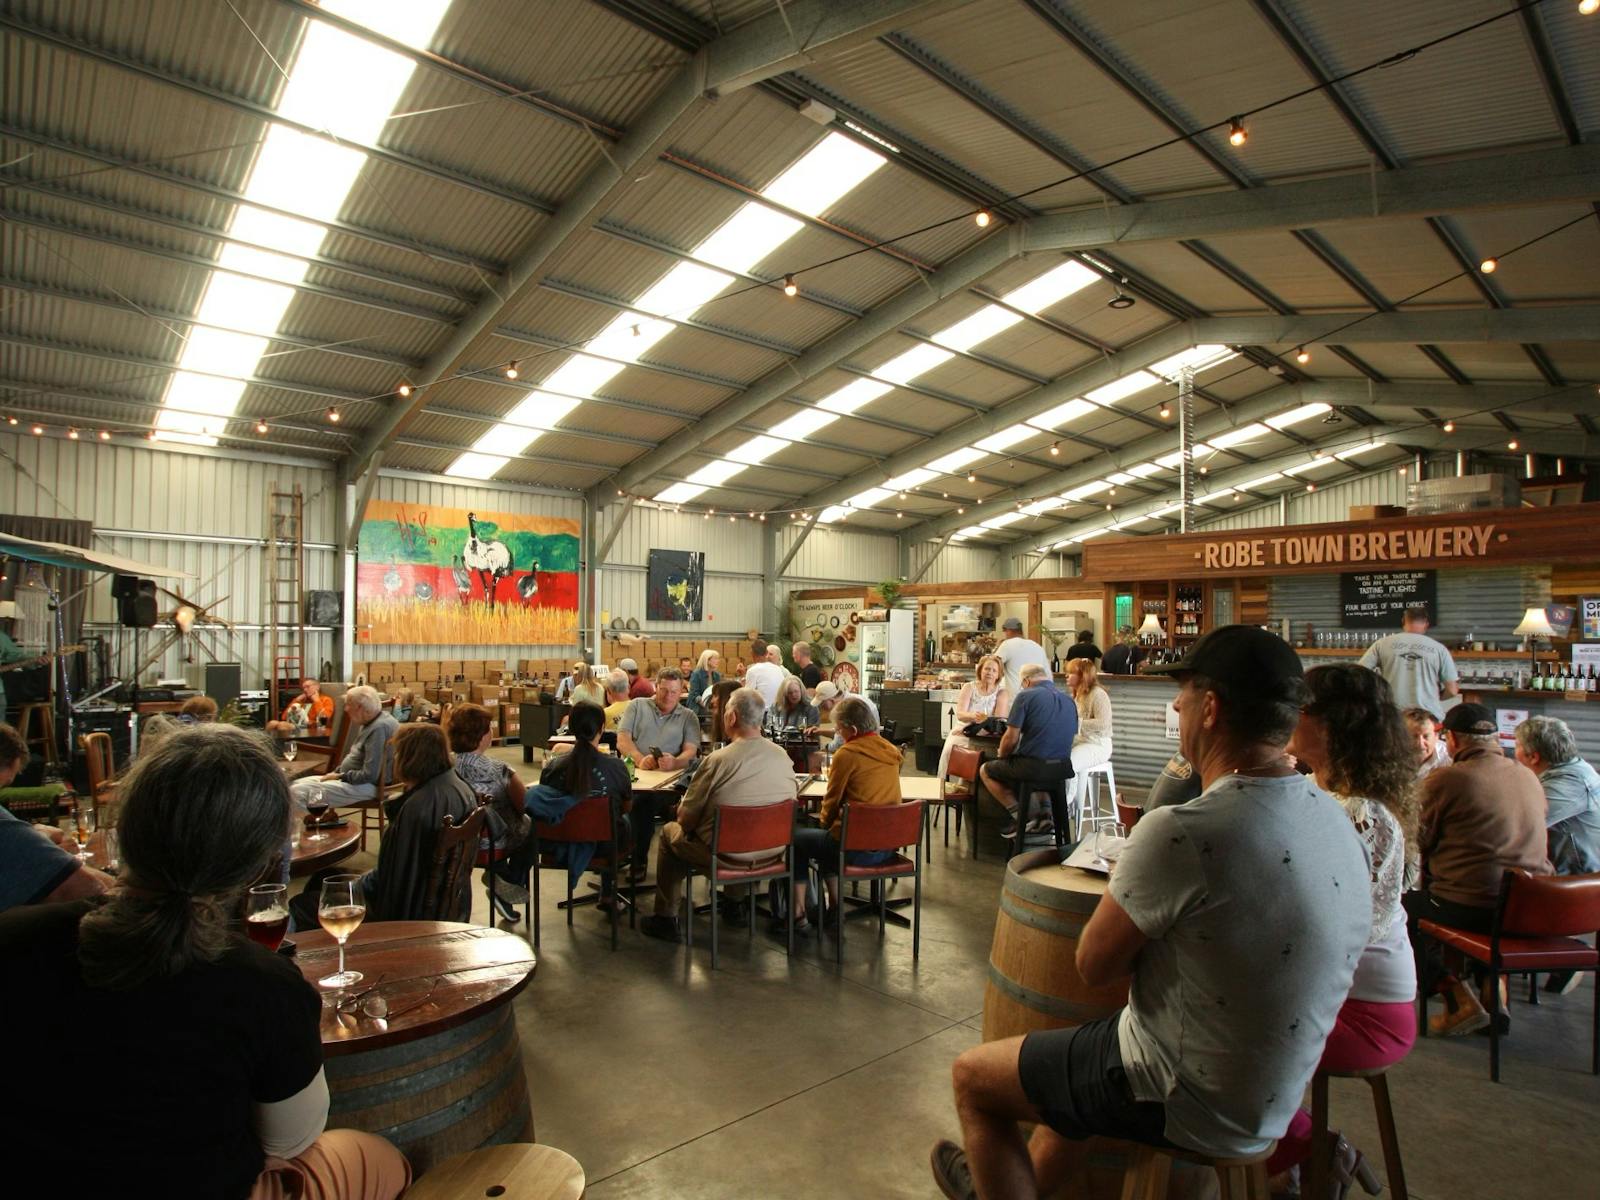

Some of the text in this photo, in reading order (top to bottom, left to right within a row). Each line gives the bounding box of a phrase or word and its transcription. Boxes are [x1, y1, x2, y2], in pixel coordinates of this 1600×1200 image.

[1204, 524, 1496, 568] ROBE TOWN BREWERY
[1358, 585, 1417, 594] TASTING FLIGHTS
